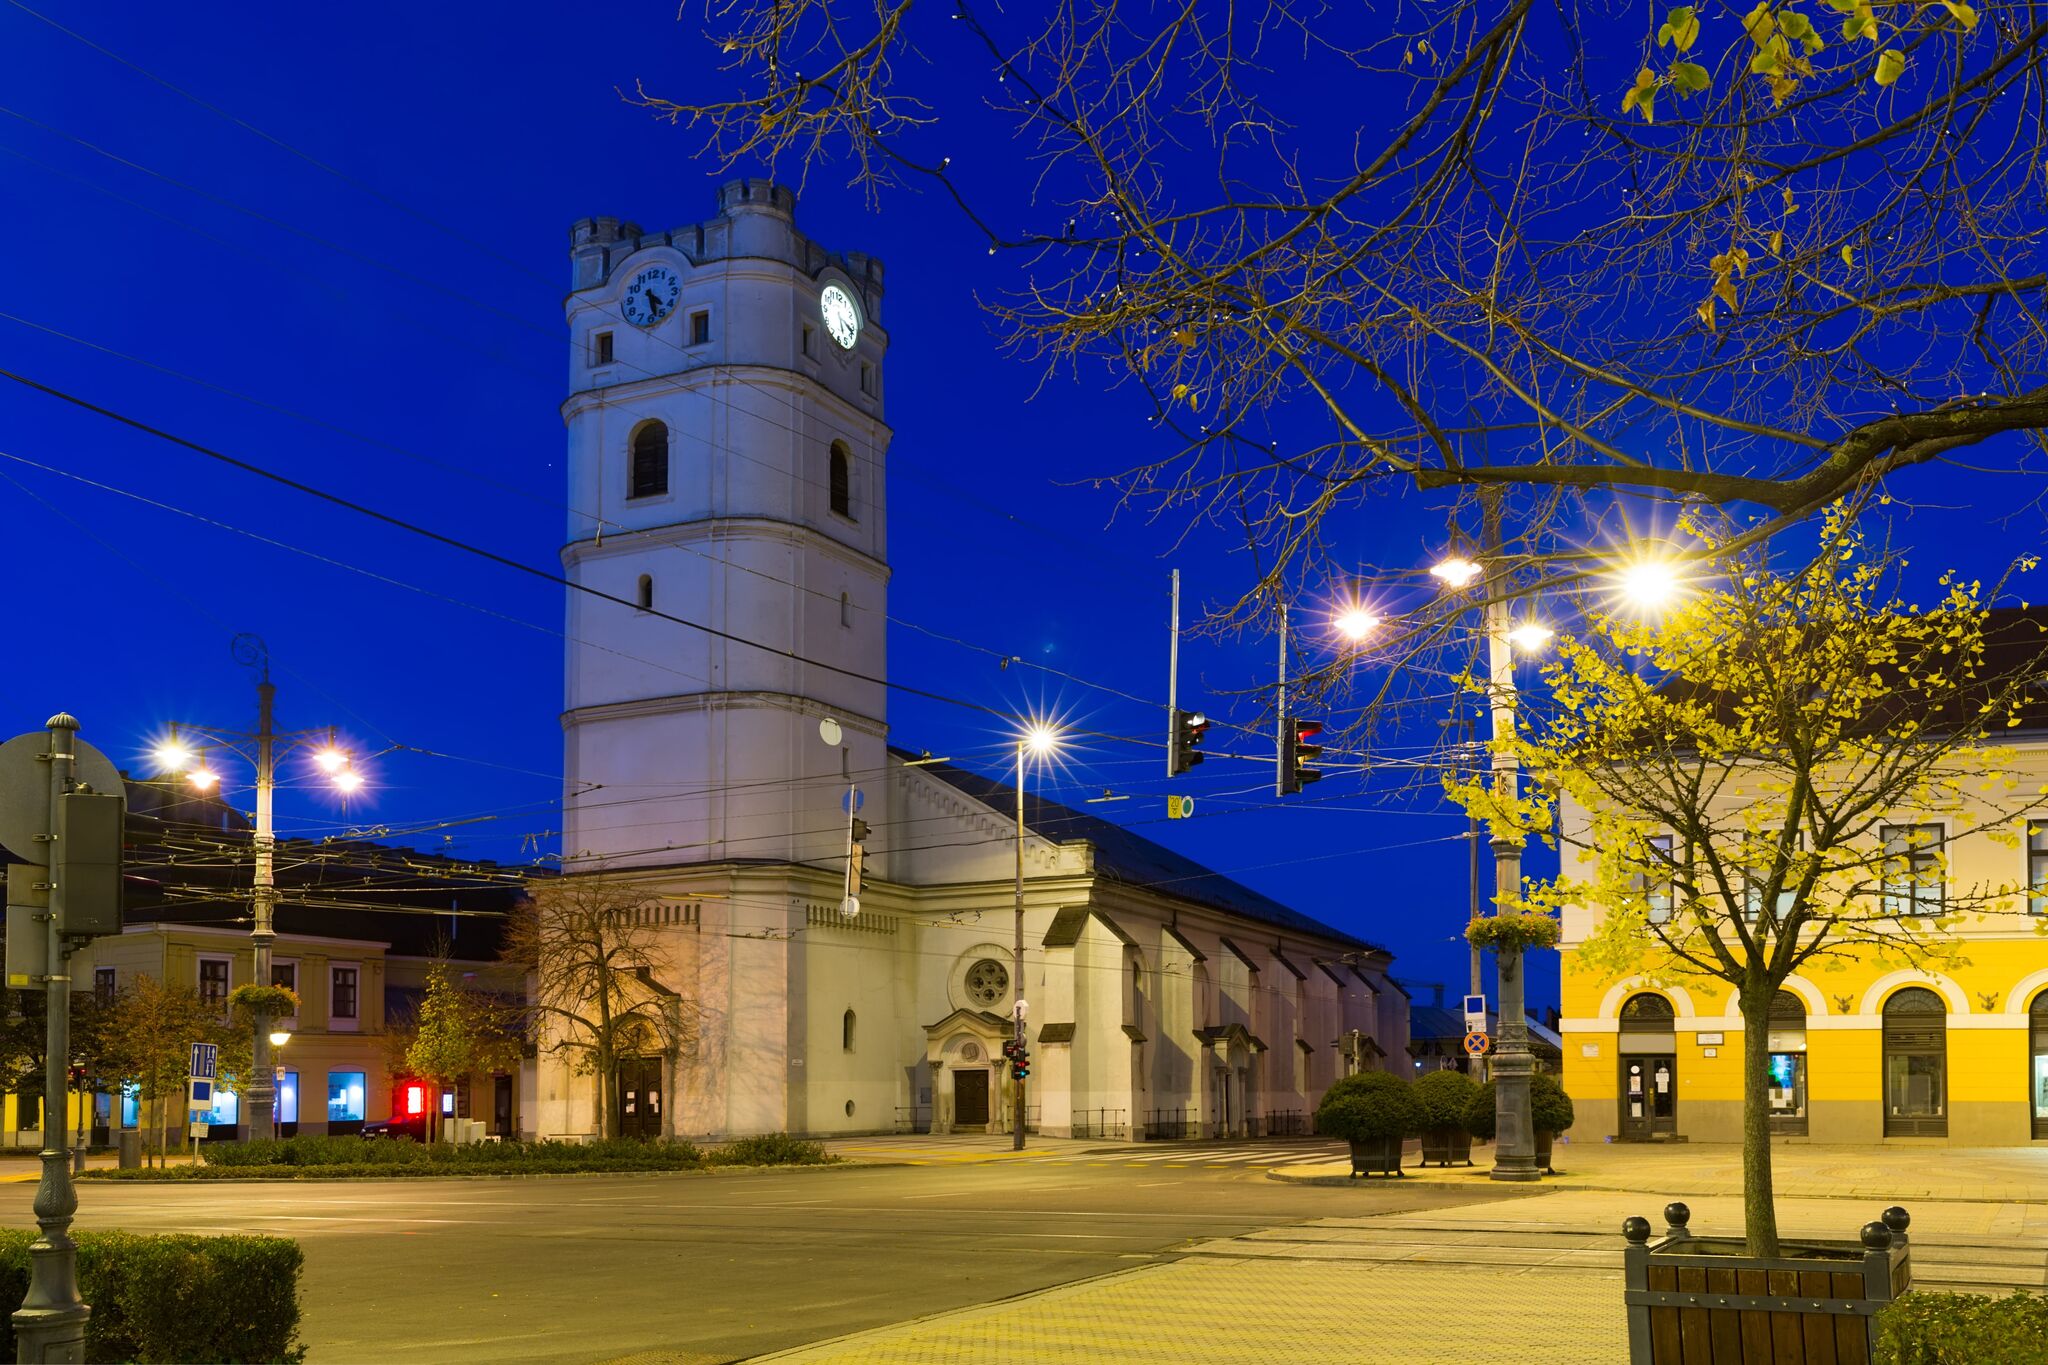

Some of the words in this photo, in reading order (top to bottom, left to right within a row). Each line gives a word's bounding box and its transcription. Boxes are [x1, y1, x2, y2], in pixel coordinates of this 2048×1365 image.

[638, 274, 646, 284] 11
[648, 269, 660, 280] 12
[661, 271, 666, 280] 1
[668, 276, 676, 286] 2
[628, 284, 641, 294] 10
[671, 287, 678, 296] 3
[626, 296, 634, 306] 9
[666, 298, 674, 308] 4
[628, 307, 636, 316] 8
[659, 308, 666, 318] 5
[637, 313, 645, 322] 7
